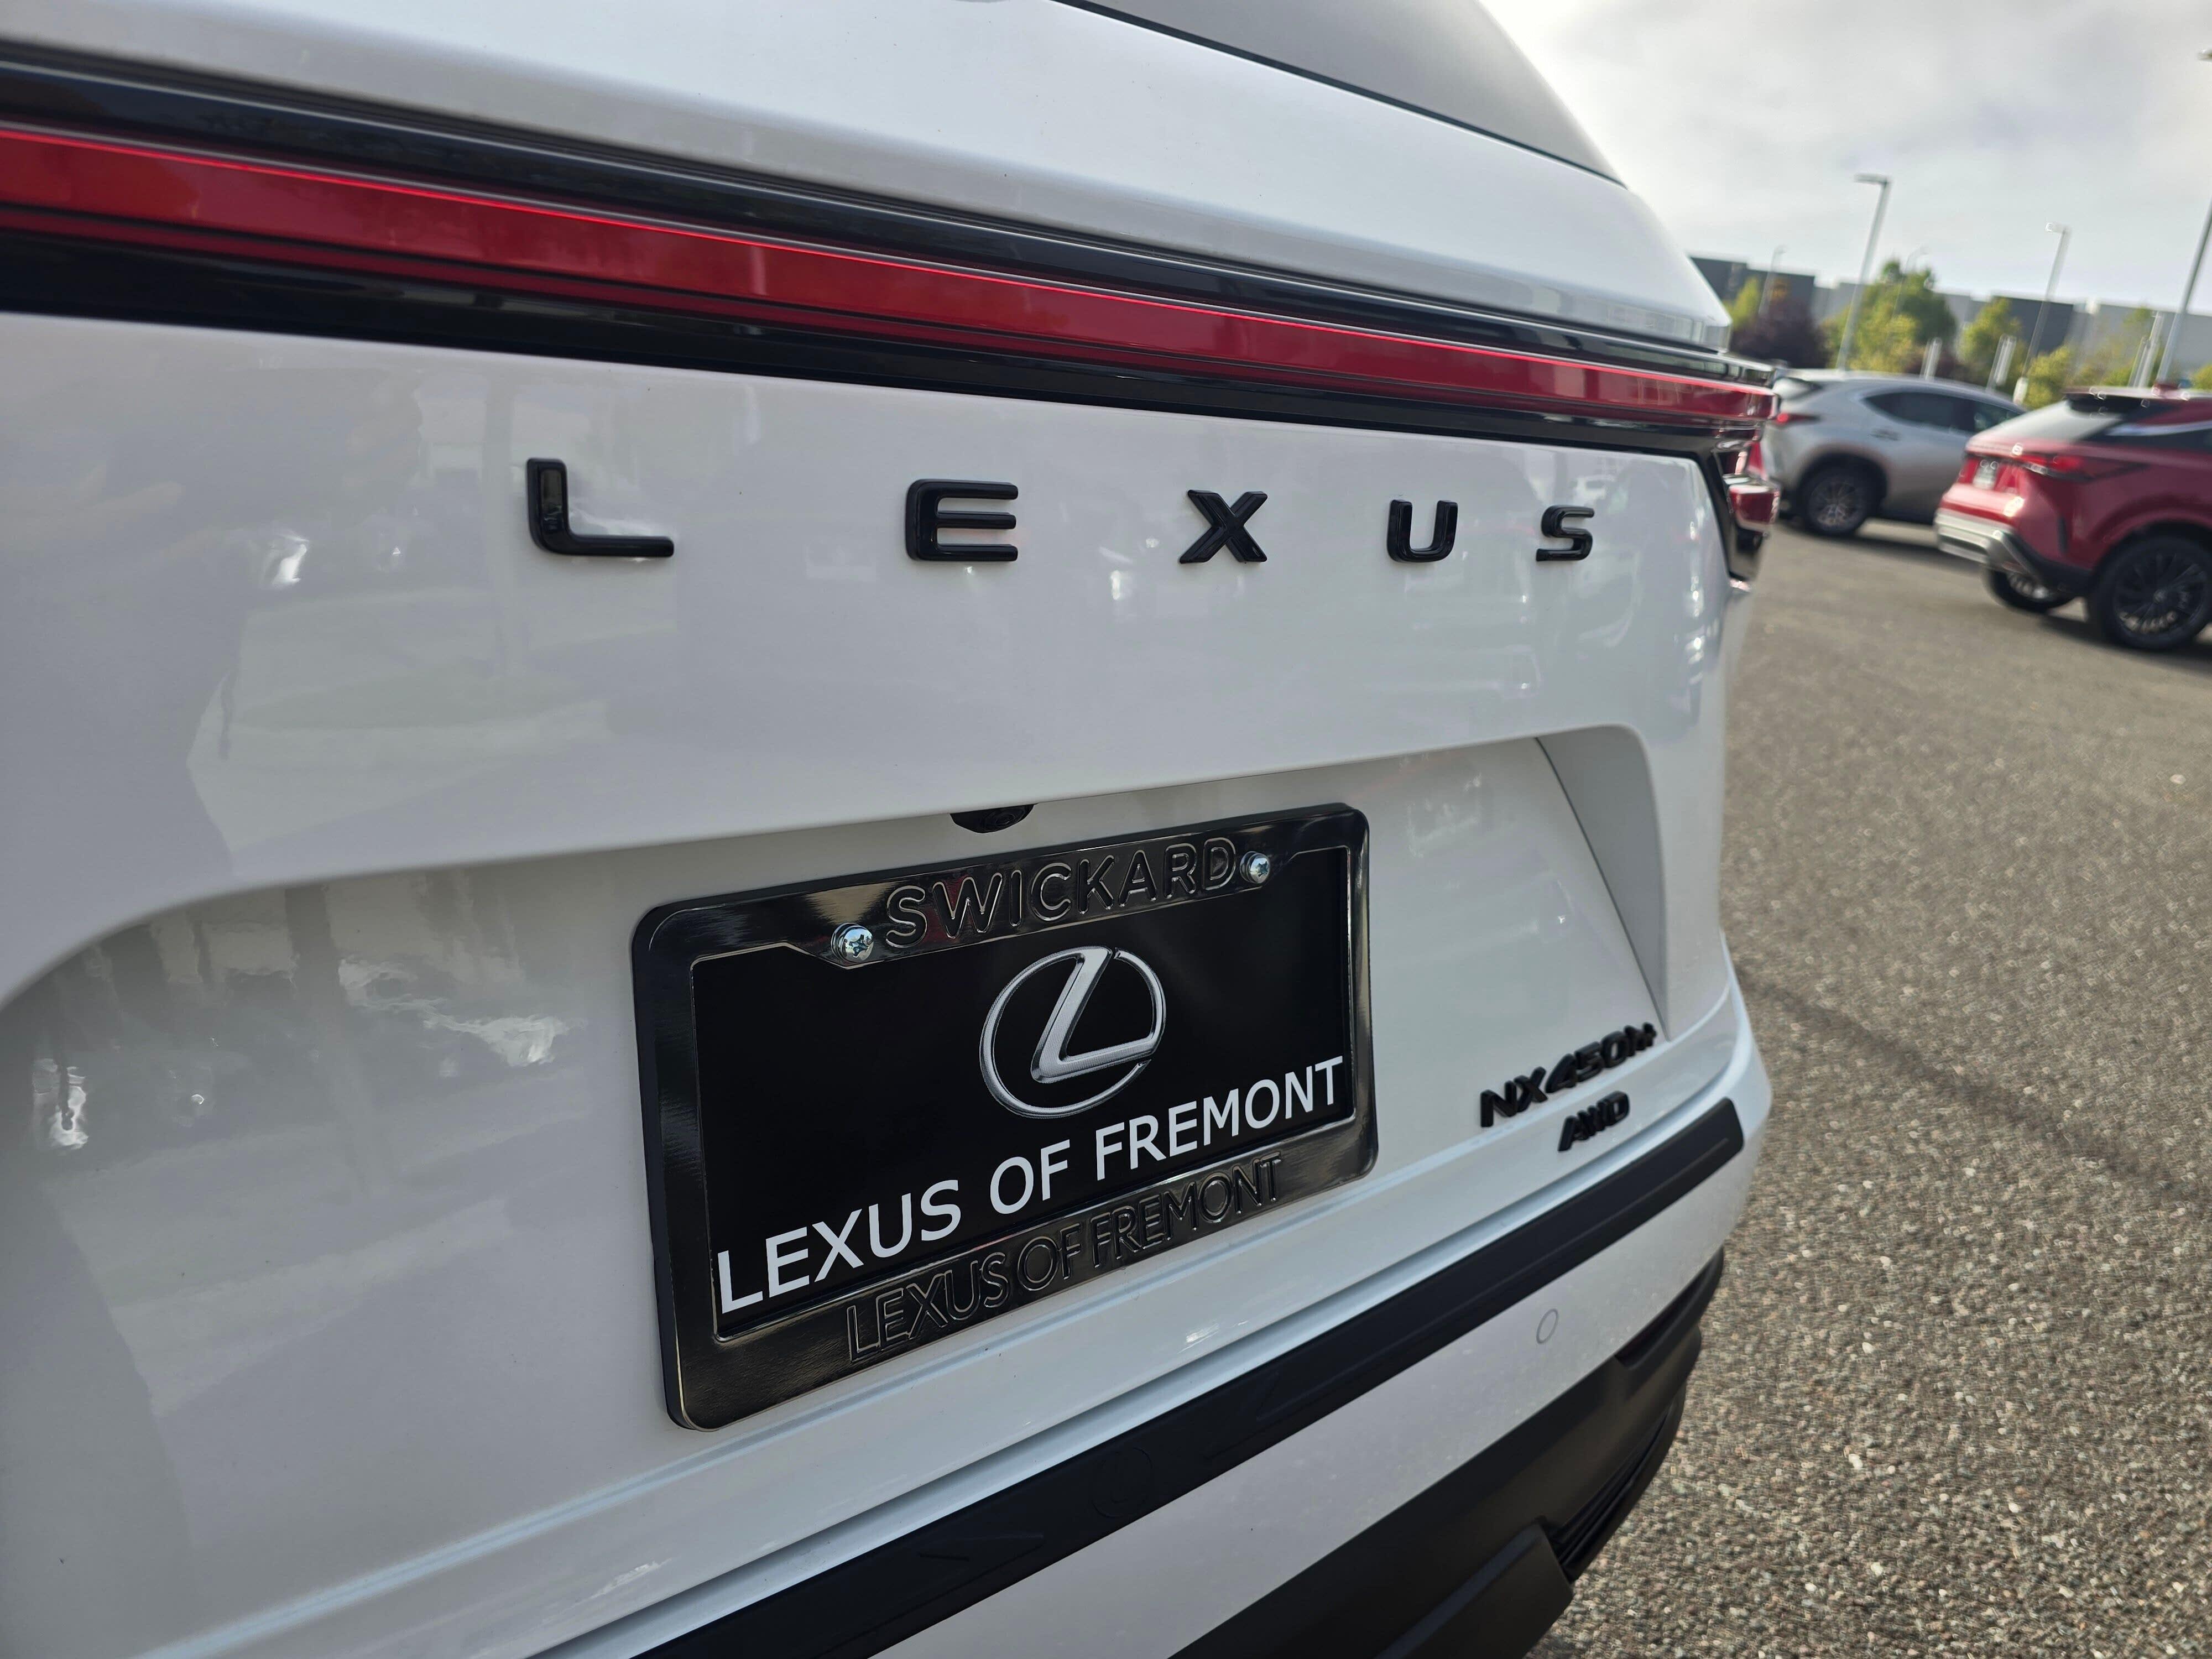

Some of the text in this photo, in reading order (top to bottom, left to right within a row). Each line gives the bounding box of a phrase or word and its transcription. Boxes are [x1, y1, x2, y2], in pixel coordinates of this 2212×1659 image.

[526, 457, 1595, 564] LEXUS
[885, 837, 1237, 948] SWICKARD
[1557, 1090, 1630, 1151] AWD
[717, 1055, 1343, 1314] LEXUS OF FREMONT
[847, 1151, 1282, 1363] LEXUS OF FREMONT
